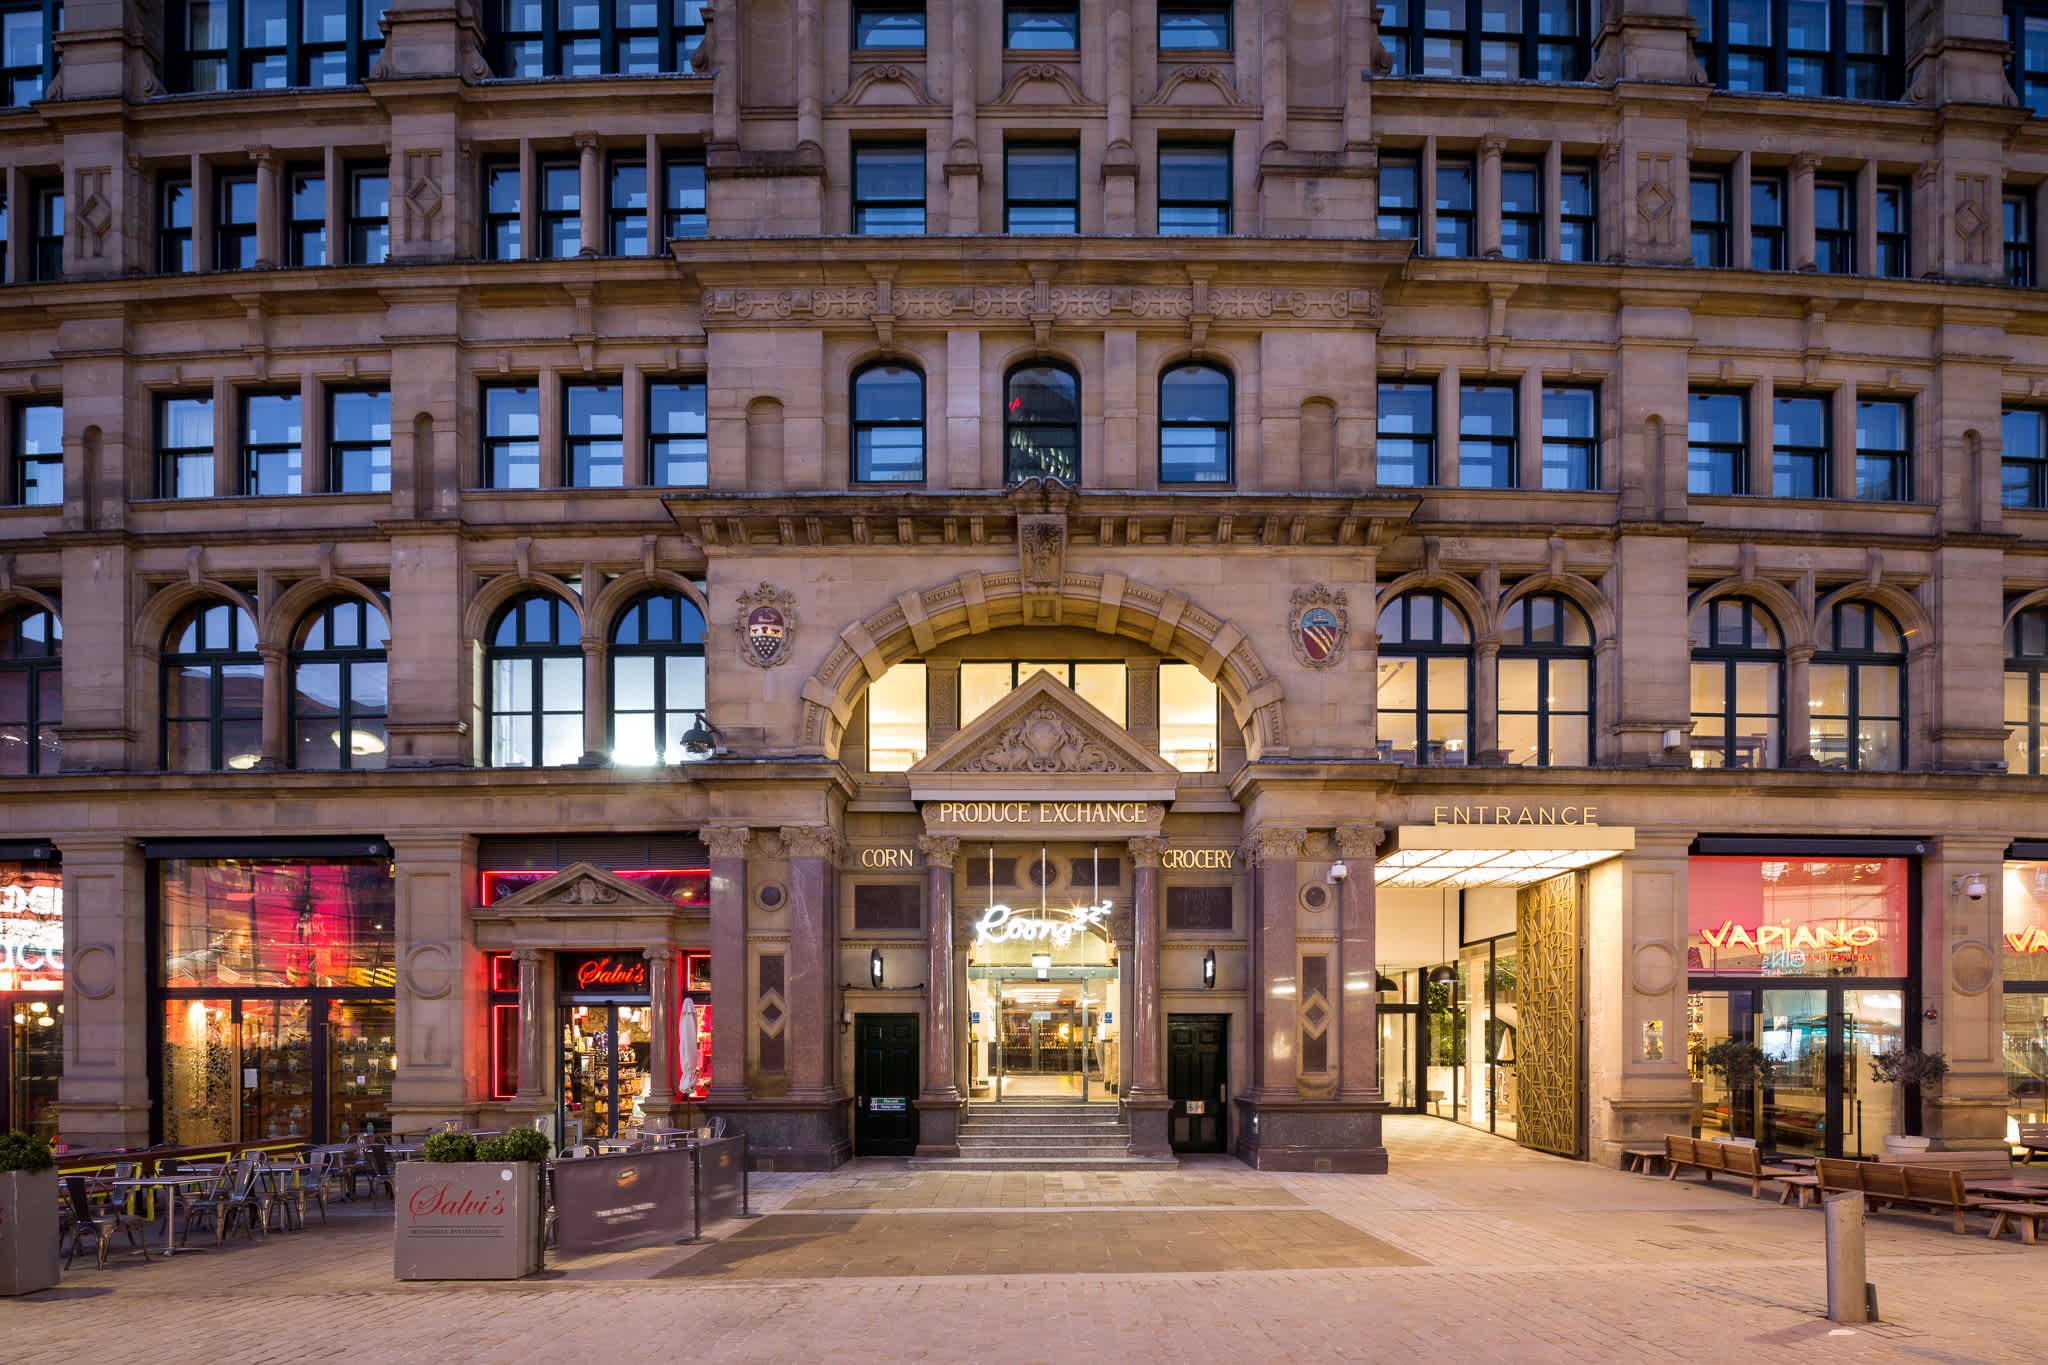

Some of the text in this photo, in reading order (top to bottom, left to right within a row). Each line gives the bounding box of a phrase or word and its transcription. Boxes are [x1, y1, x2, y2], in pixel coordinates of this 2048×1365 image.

[940, 802, 1148, 823] PRODUCE EXCHANGE
[1434, 805, 1600, 826] ENTRANCE
[861, 848, 914, 868] CORN
[1162, 849, 1236, 869] GROCERY
[577, 957, 646, 990] Salvi's
[408, 1181, 505, 1225] Salvi's
